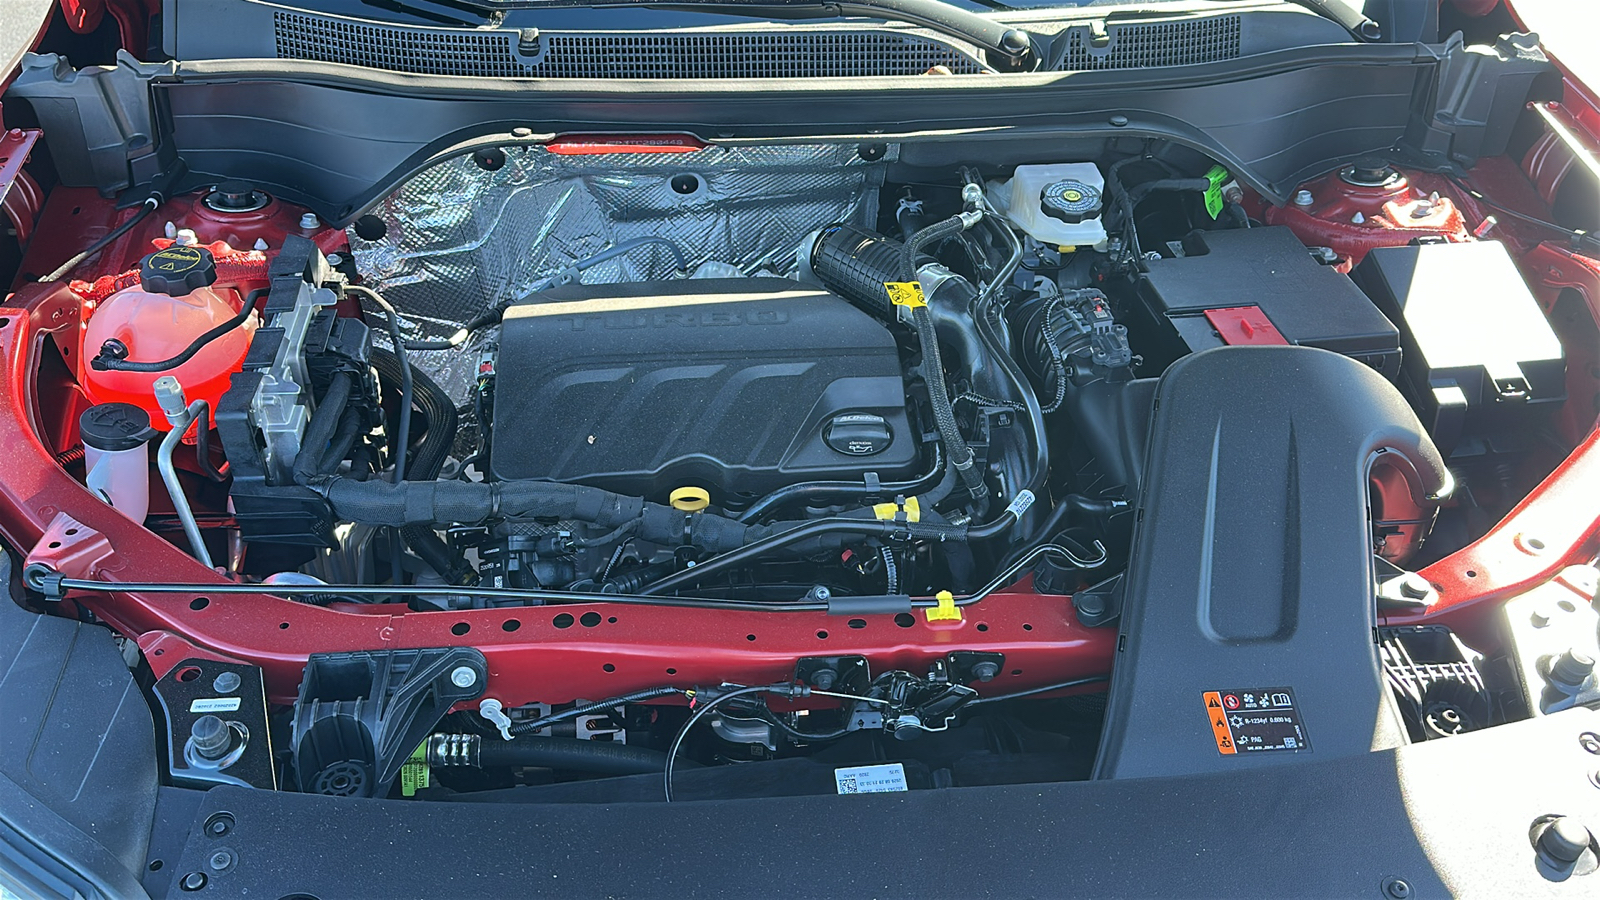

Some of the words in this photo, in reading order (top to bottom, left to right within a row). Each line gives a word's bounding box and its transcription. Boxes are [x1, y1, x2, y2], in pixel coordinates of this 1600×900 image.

[560, 309, 790, 331] TURBO
[1244, 717, 1268, 725] R-1234yf
[1284, 716, 1292, 724] kg
